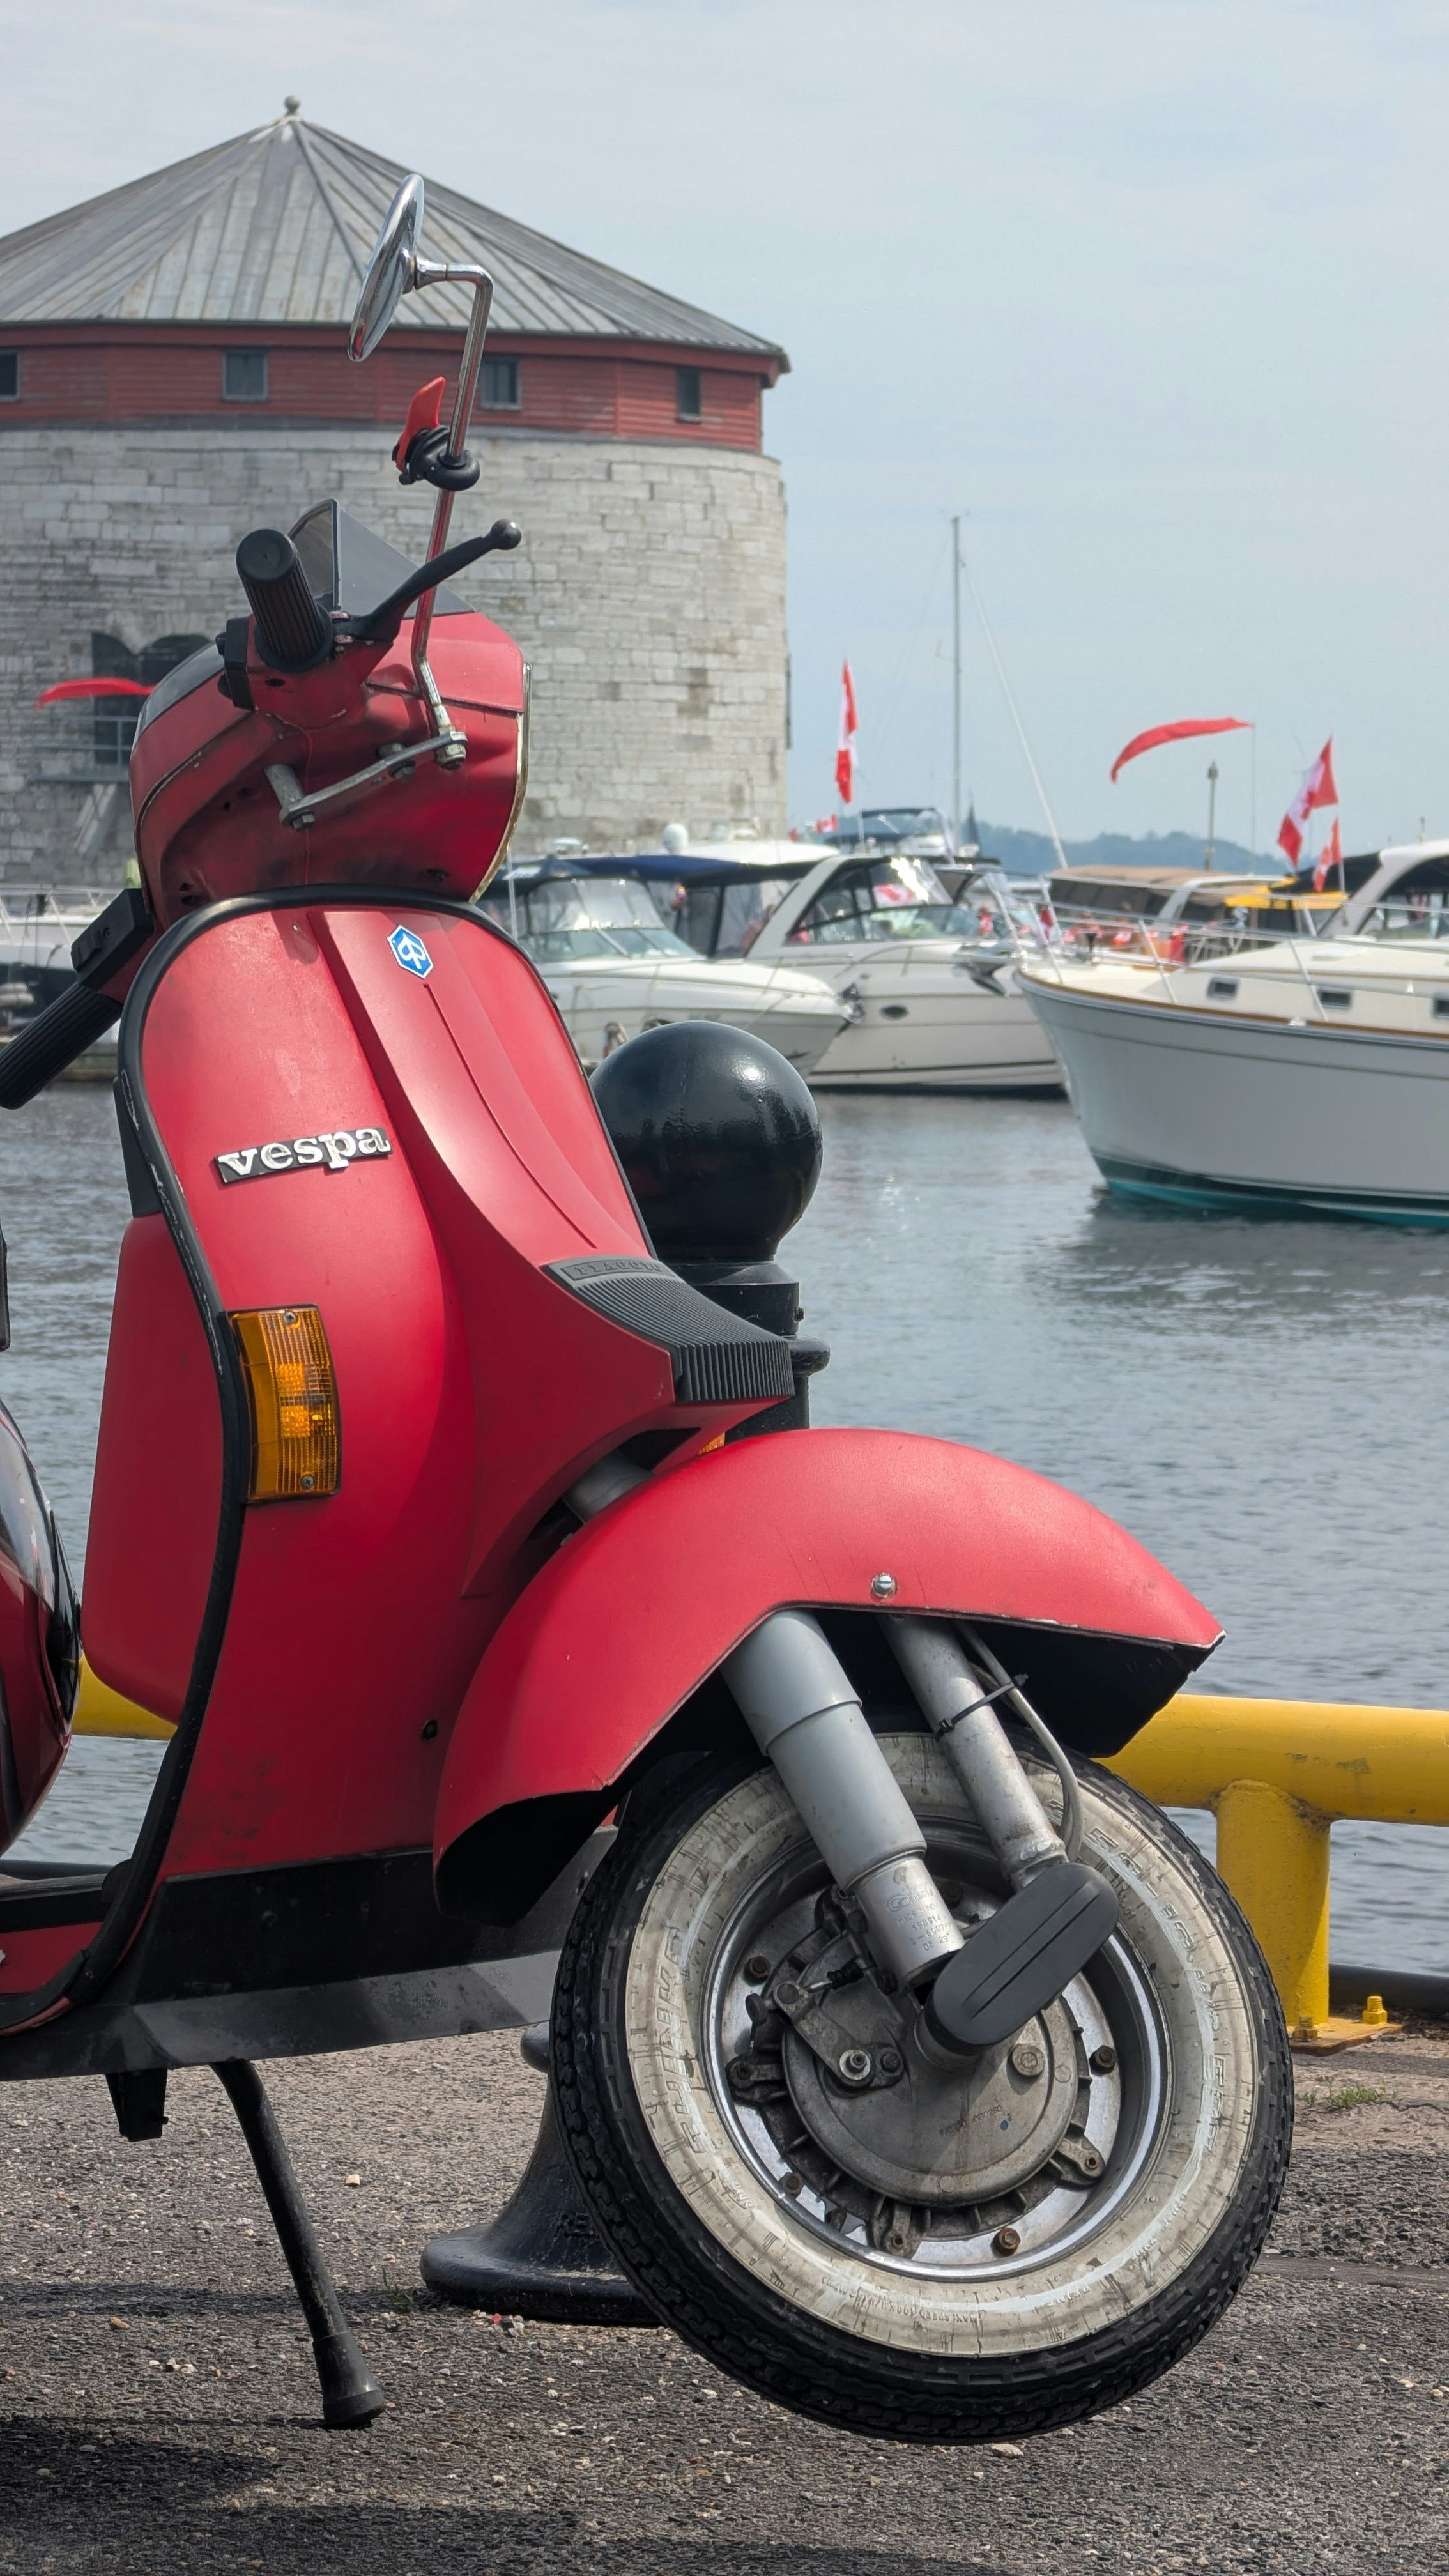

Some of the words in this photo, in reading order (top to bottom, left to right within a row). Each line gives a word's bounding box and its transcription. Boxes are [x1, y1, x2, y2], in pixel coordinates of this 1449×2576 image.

[218, 1128, 391, 1176] vespa
[574, 1261, 663, 1275] PIAGGIO
[923, 1940, 934, 1951] 05
[657, 1926, 716, 2155] SHINKO
